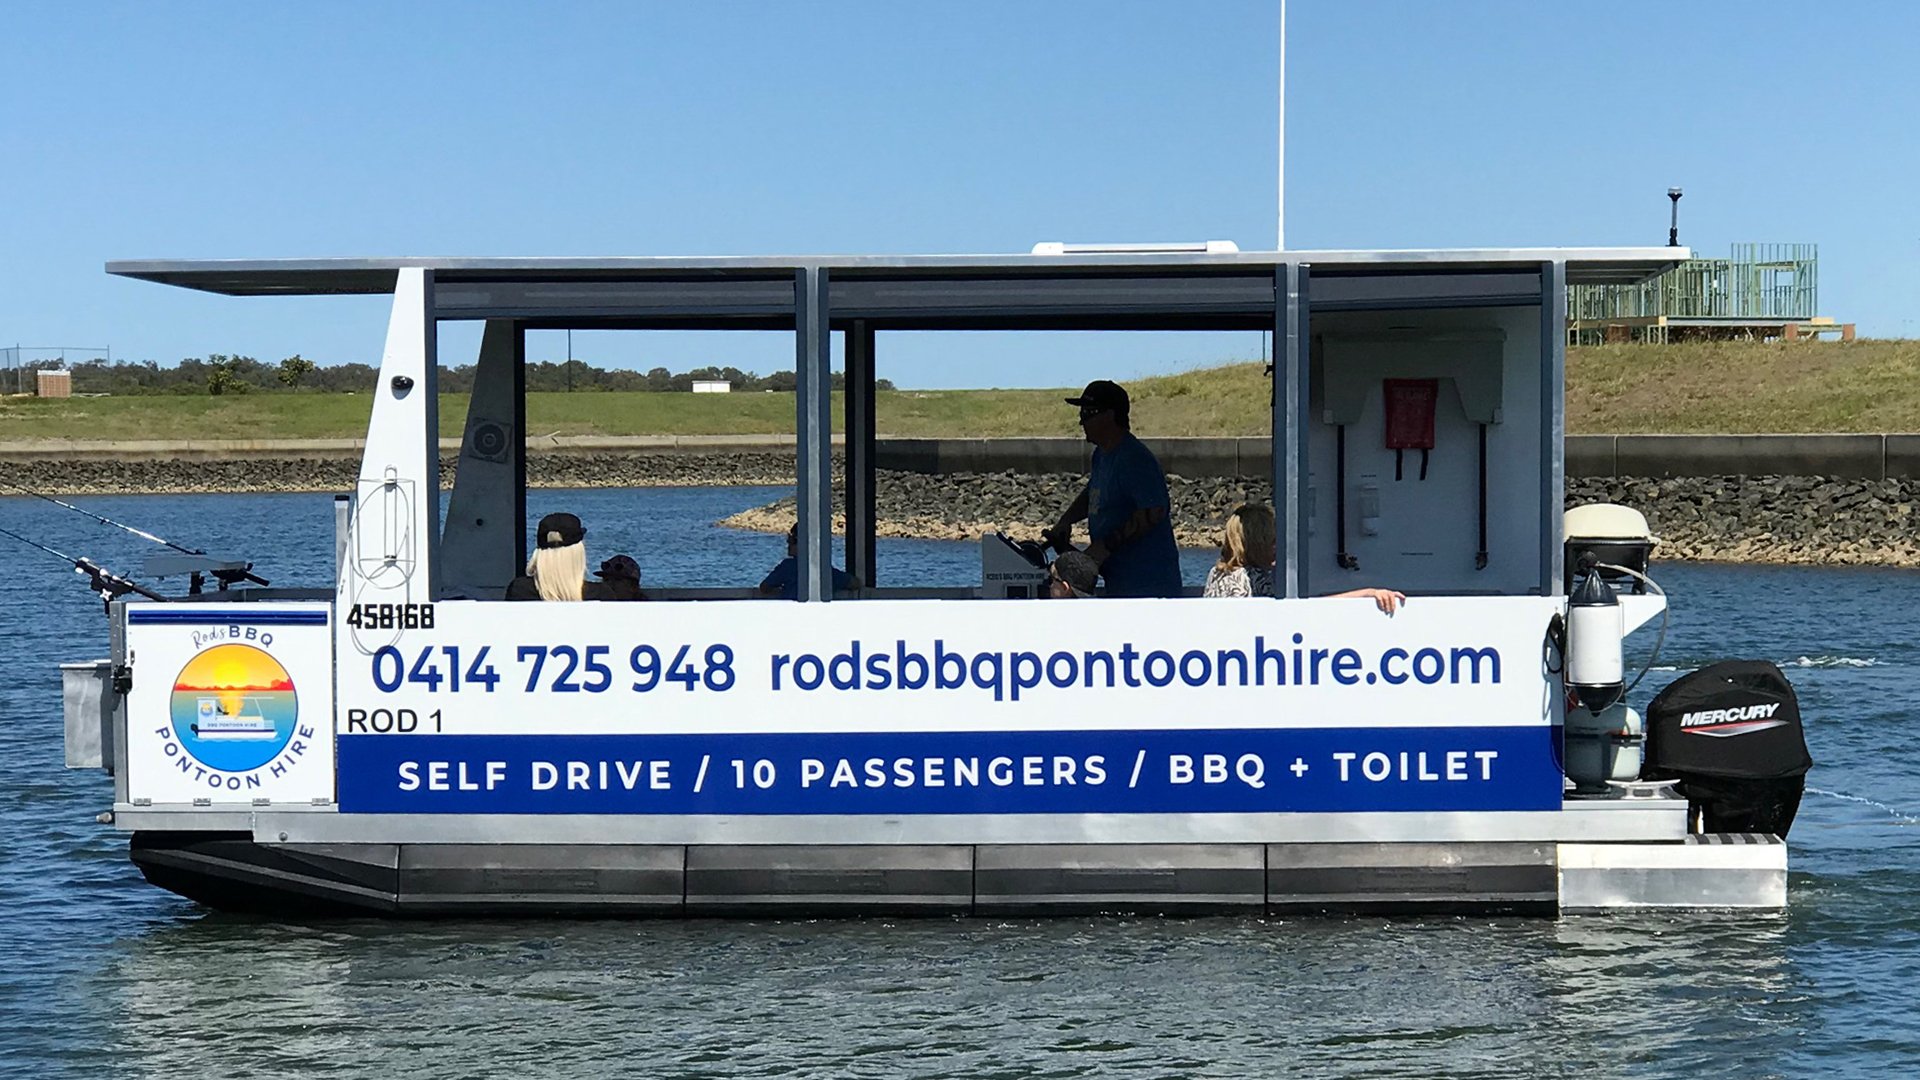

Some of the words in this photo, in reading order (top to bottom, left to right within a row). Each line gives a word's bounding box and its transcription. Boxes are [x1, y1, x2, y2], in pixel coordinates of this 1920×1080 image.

[346, 603, 434, 630] 458168
[229, 624, 273, 648] BBQ
[372, 645, 500, 693] 0414
[518, 645, 612, 693] 725
[630, 644, 735, 692] 948
[772, 633, 1500, 702] rodsbbqpontoonhire.com
[349, 708, 417, 733] ROD
[429, 709, 442, 732] 1
[1680, 702, 1780, 726] MERCURY
[155, 726, 261, 790] PONTOON
[270, 724, 314, 778] HIRE
[399, 762, 506, 790] SELF
[532, 761, 670, 789] DRIVE
[731, 760, 776, 788] 10
[801, 756, 1107, 788] PASSENGERS
[1169, 754, 1266, 788] BBQ
[1333, 752, 1497, 782] TOILET
